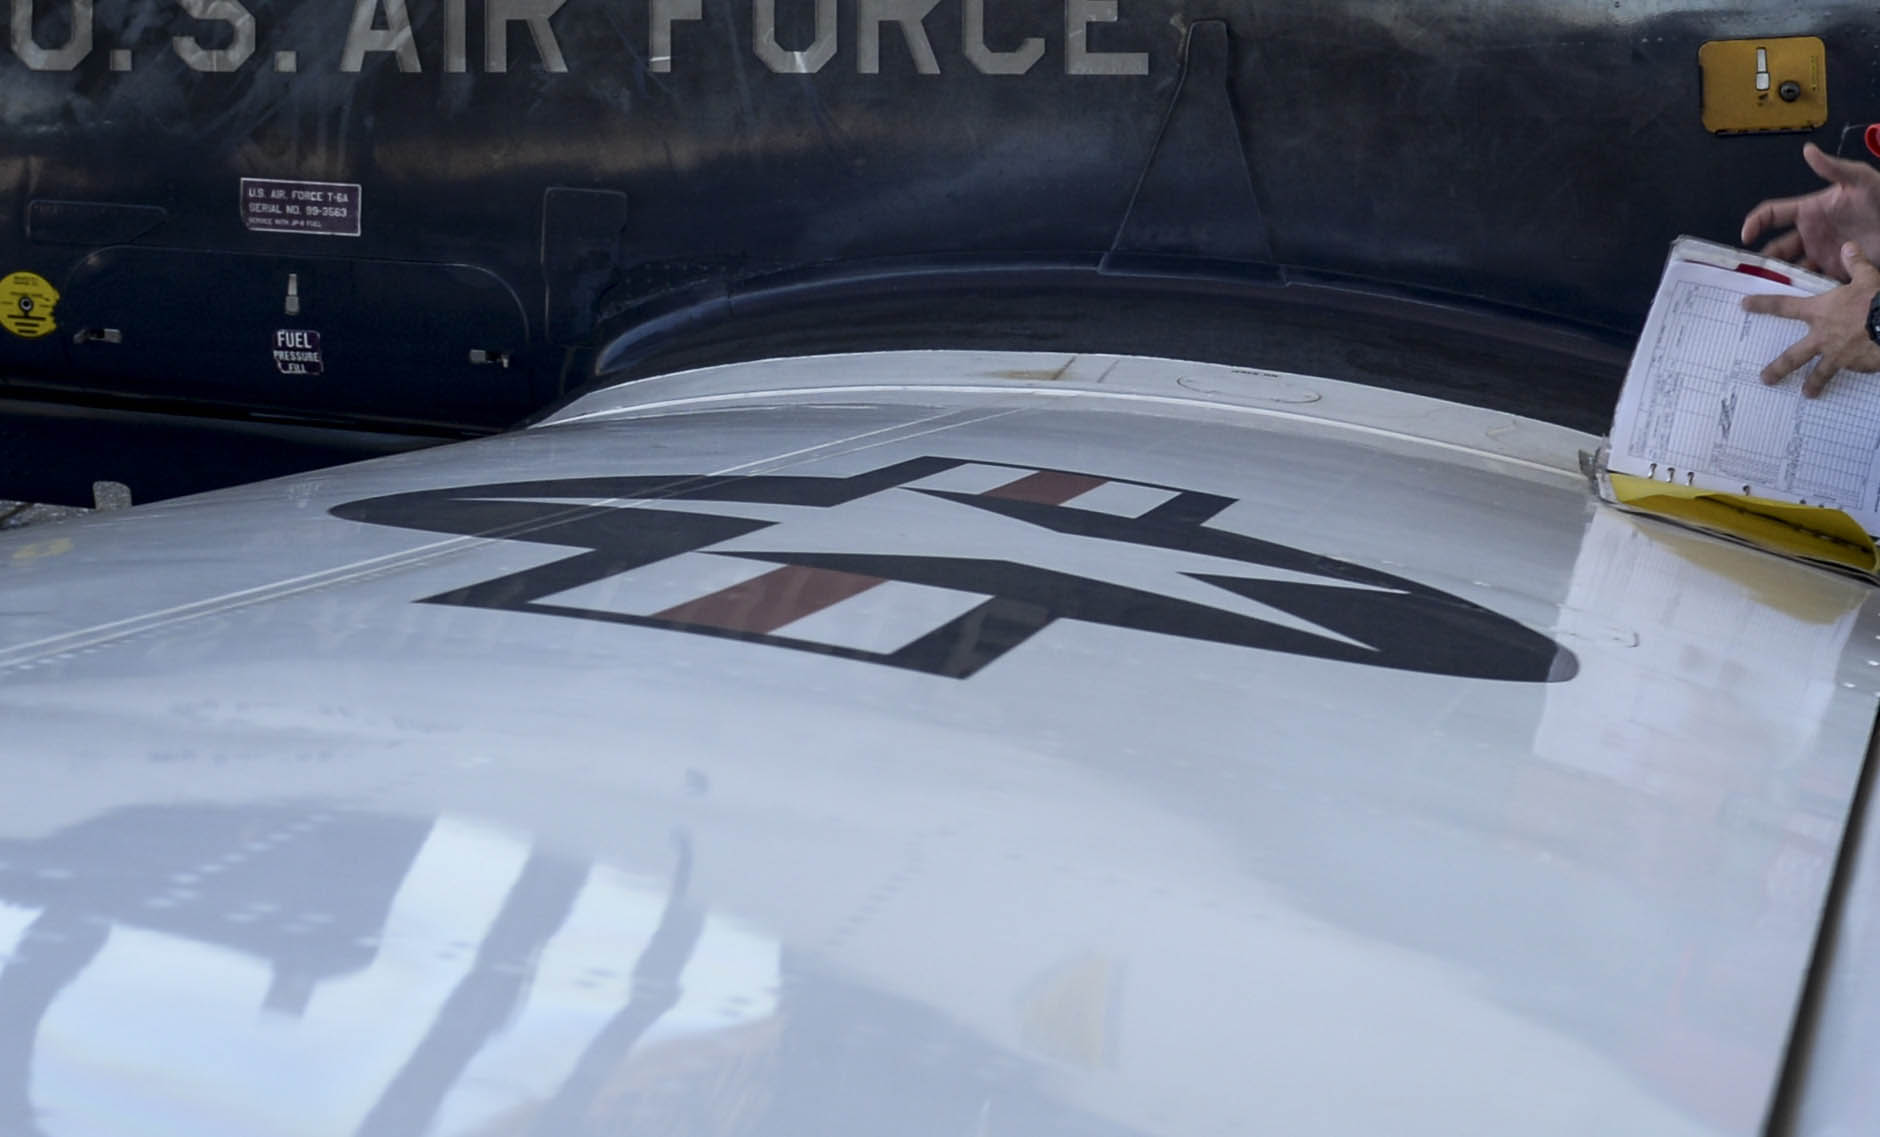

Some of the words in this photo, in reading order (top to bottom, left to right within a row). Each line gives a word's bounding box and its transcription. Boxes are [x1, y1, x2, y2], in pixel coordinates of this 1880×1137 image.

[292, 190, 323, 202] FORCE
[328, 192, 349, 203] T-6A
[248, 202, 282, 214] SERIAL
[286, 204, 302, 216] NO.
[277, 330, 312, 349] FUEL
[273, 350, 320, 362] PRESSURE
